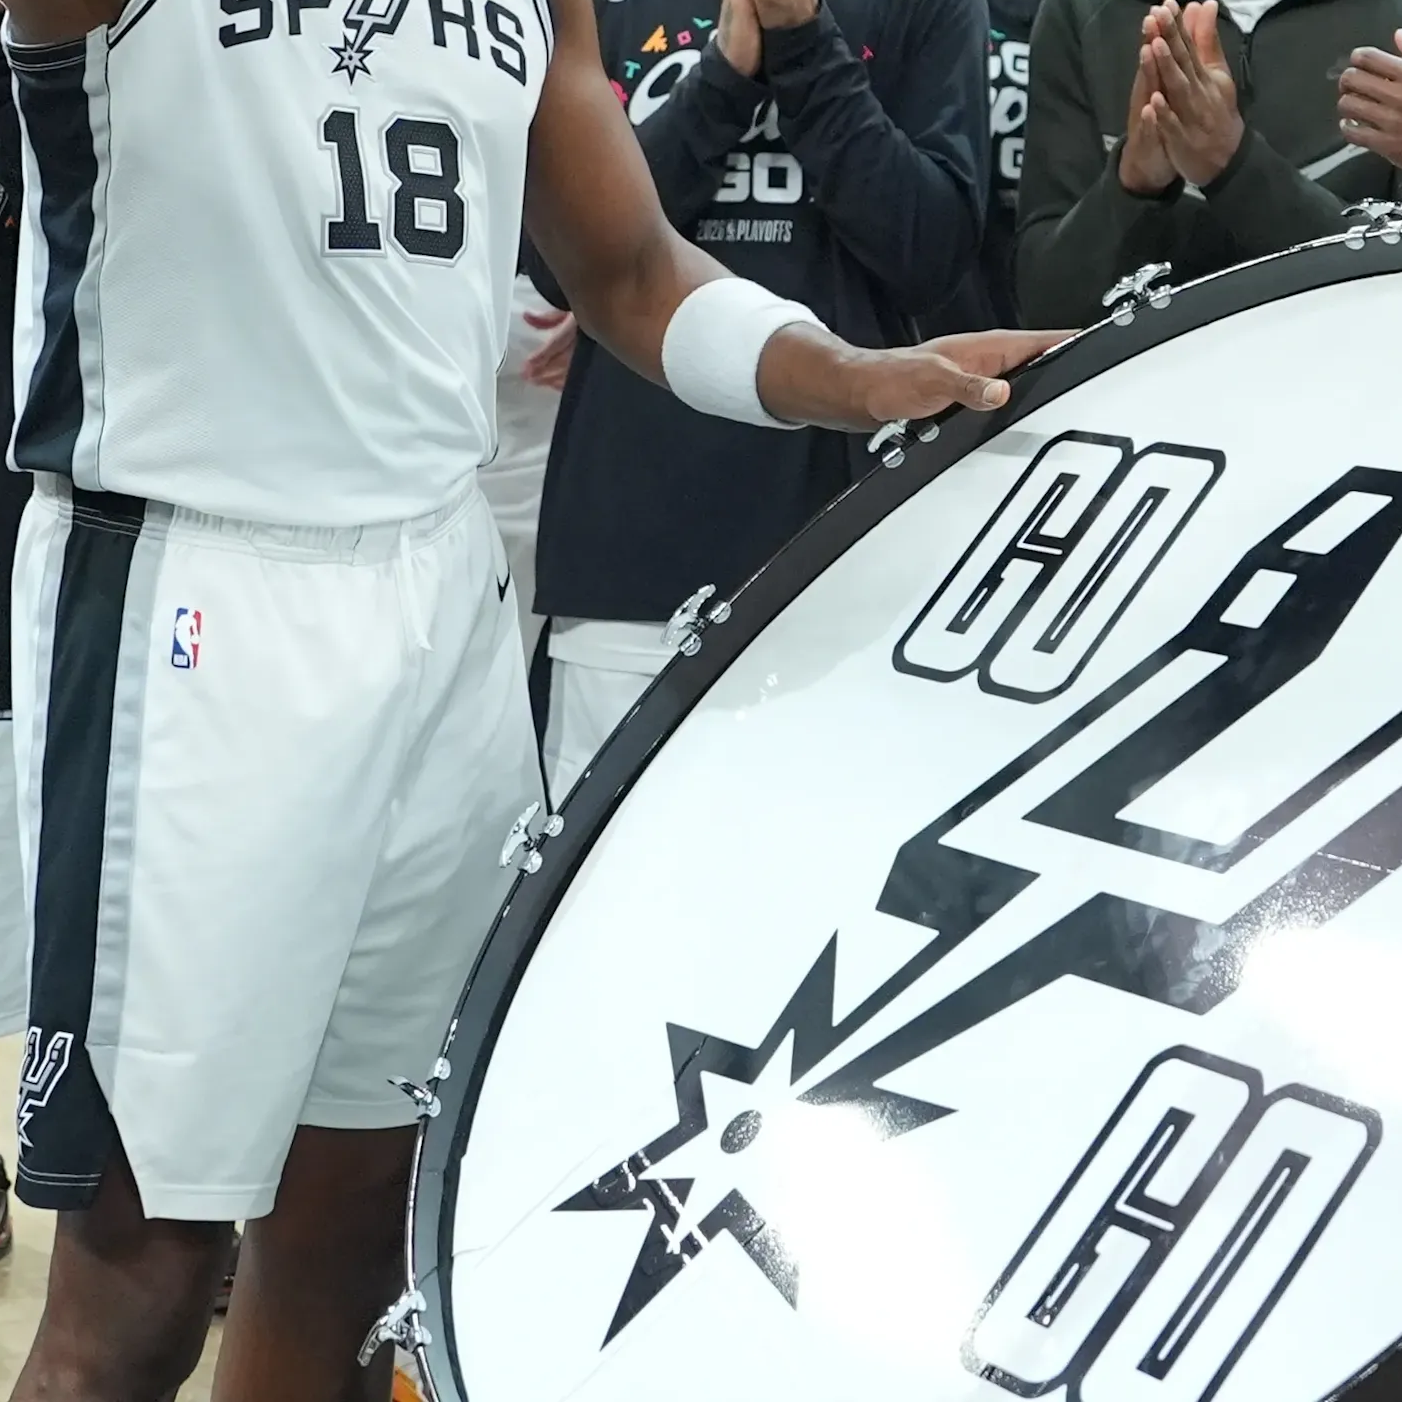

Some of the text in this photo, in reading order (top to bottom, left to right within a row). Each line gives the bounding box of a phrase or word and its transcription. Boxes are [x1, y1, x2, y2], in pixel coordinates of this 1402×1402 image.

[319, 104, 470, 267] 18
[736, 219, 794, 242] PLAYOFFS
[892, 428, 1226, 705] GO
[959, 1043, 1384, 1402] GO
